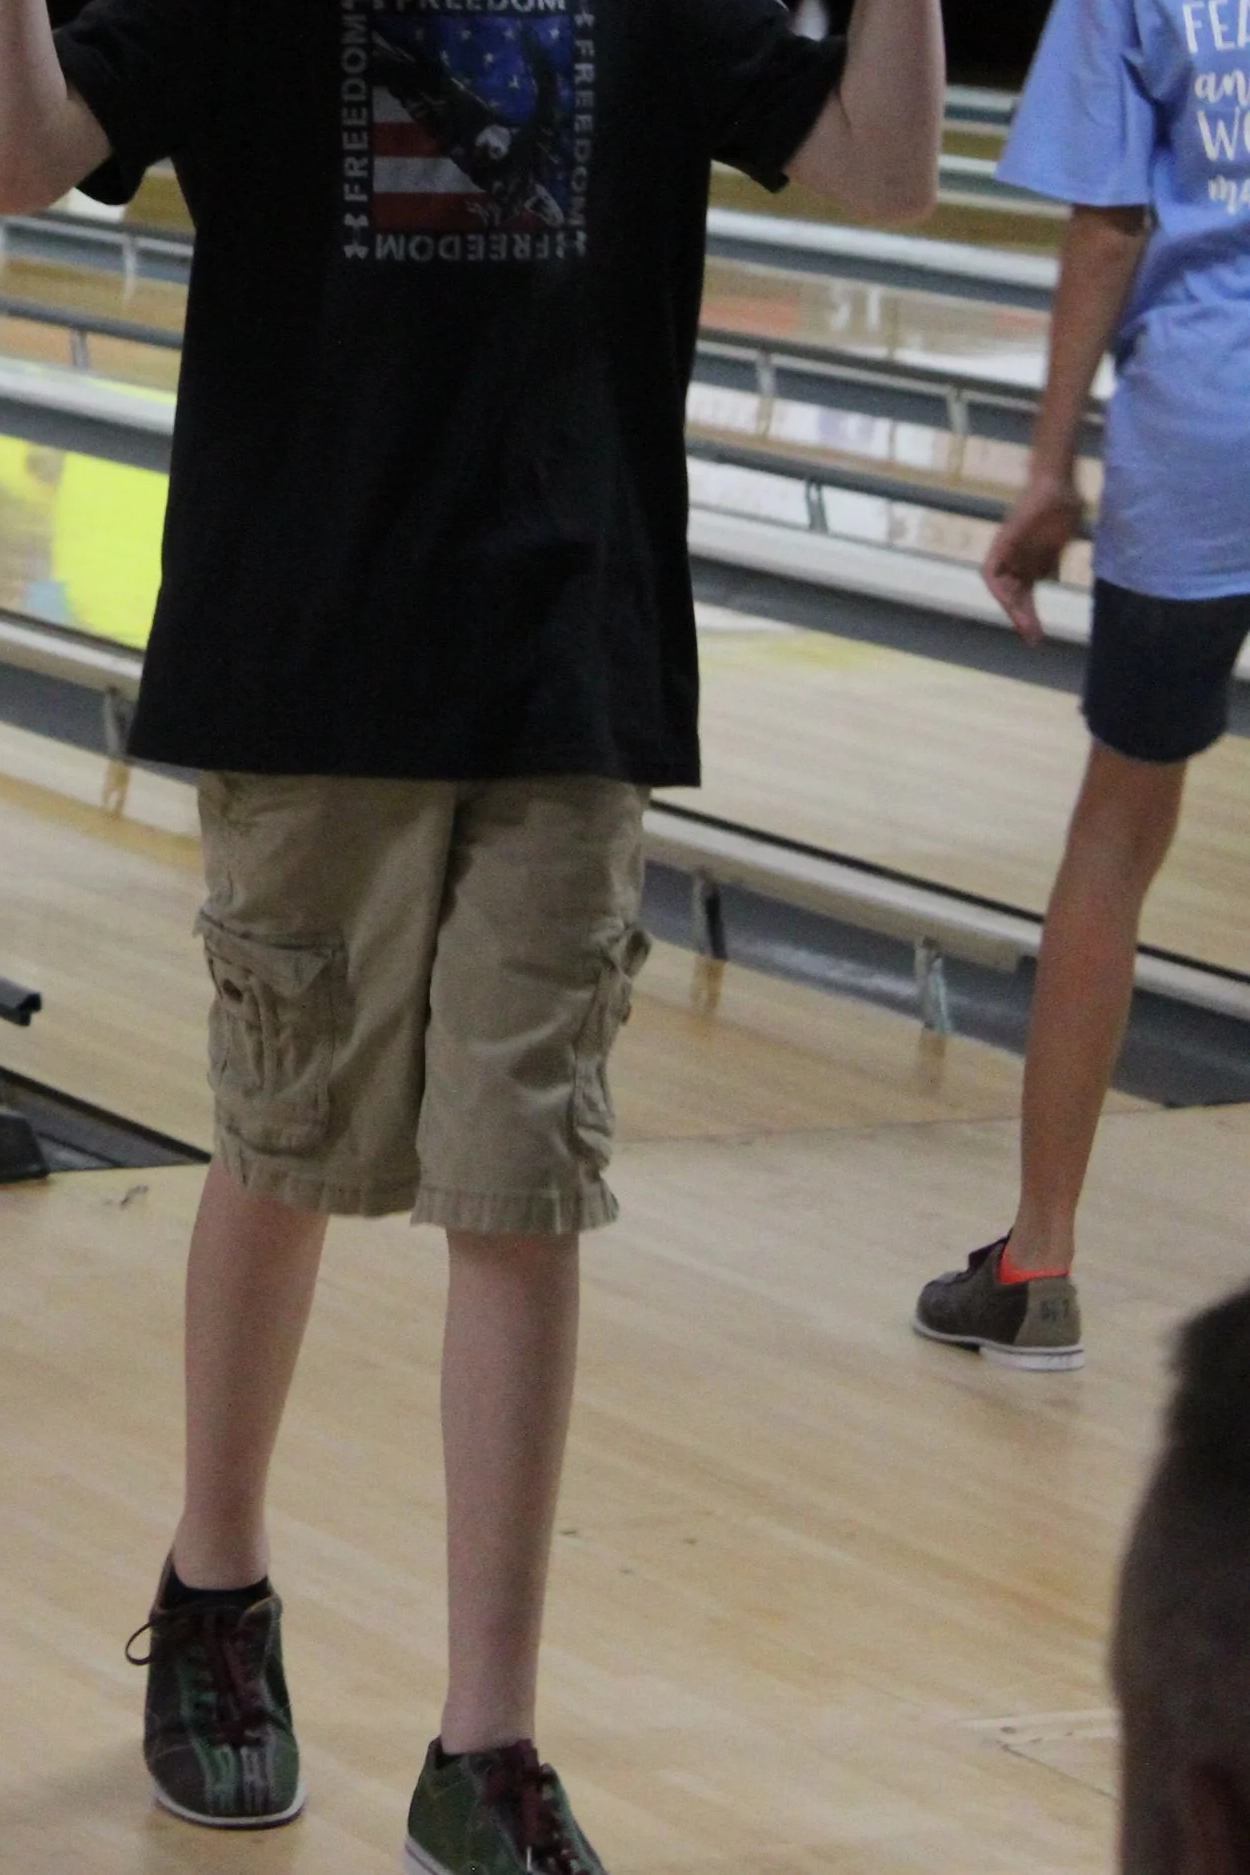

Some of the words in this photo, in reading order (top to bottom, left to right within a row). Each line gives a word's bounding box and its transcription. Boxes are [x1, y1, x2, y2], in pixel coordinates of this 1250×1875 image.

[341, 13, 368, 202] FREEDOM
[570, 39, 596, 226] FREEDOM
[374, 233, 550, 262] FREEDOM
